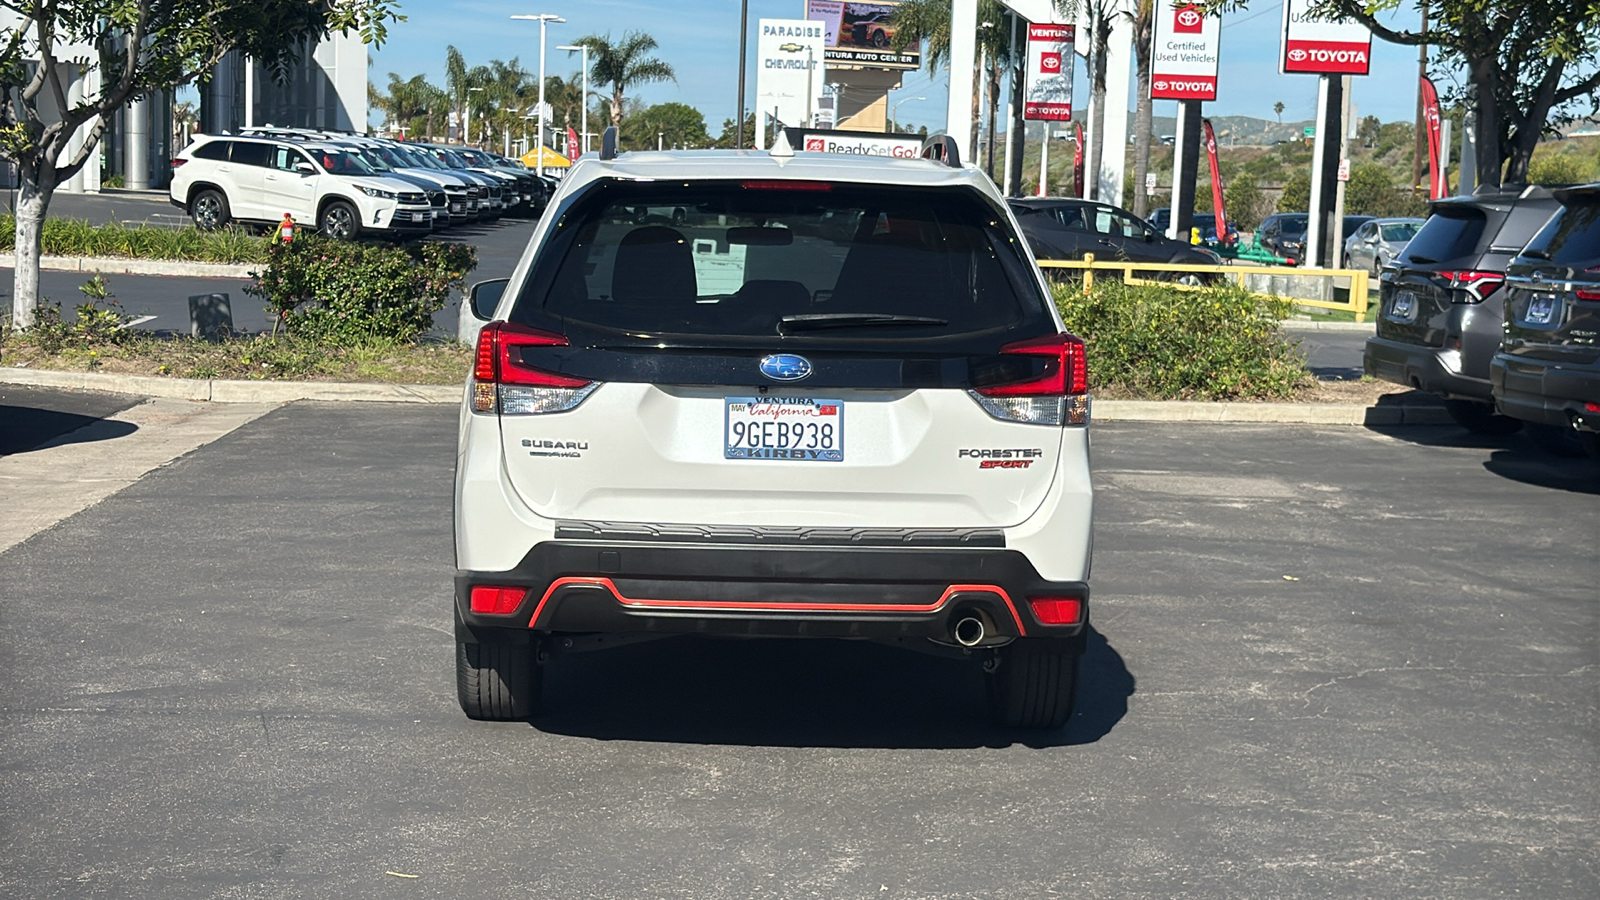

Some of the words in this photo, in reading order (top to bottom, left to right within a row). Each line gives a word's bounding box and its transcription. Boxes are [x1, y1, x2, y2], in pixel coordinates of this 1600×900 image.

[763, 25, 821, 38] PARADISE
[1031, 28, 1073, 37] VENTURA
[1166, 41, 1206, 51] Certified
[824, 51, 852, 60] NTURA
[855, 53, 878, 61] AUTO
[1155, 52, 1178, 62] Used
[1180, 53, 1216, 63] Vehicles
[1308, 49, 1366, 64] TOYOTA
[1169, 80, 1214, 92] TOYOTA
[1038, 107, 1070, 116] TOYOTA
[828, 142, 918, 159] ReadySetGo!
[755, 397, 815, 405] VENTURA
[731, 404, 747, 412] MAY
[749, 403, 817, 420] California
[732, 421, 834, 449] 9GEB938
[521, 438, 589, 450] SUBARU
[746, 448, 822, 459] KIRBY
[958, 448, 1043, 458] FORESTER
[979, 459, 1034, 469] SPORT
